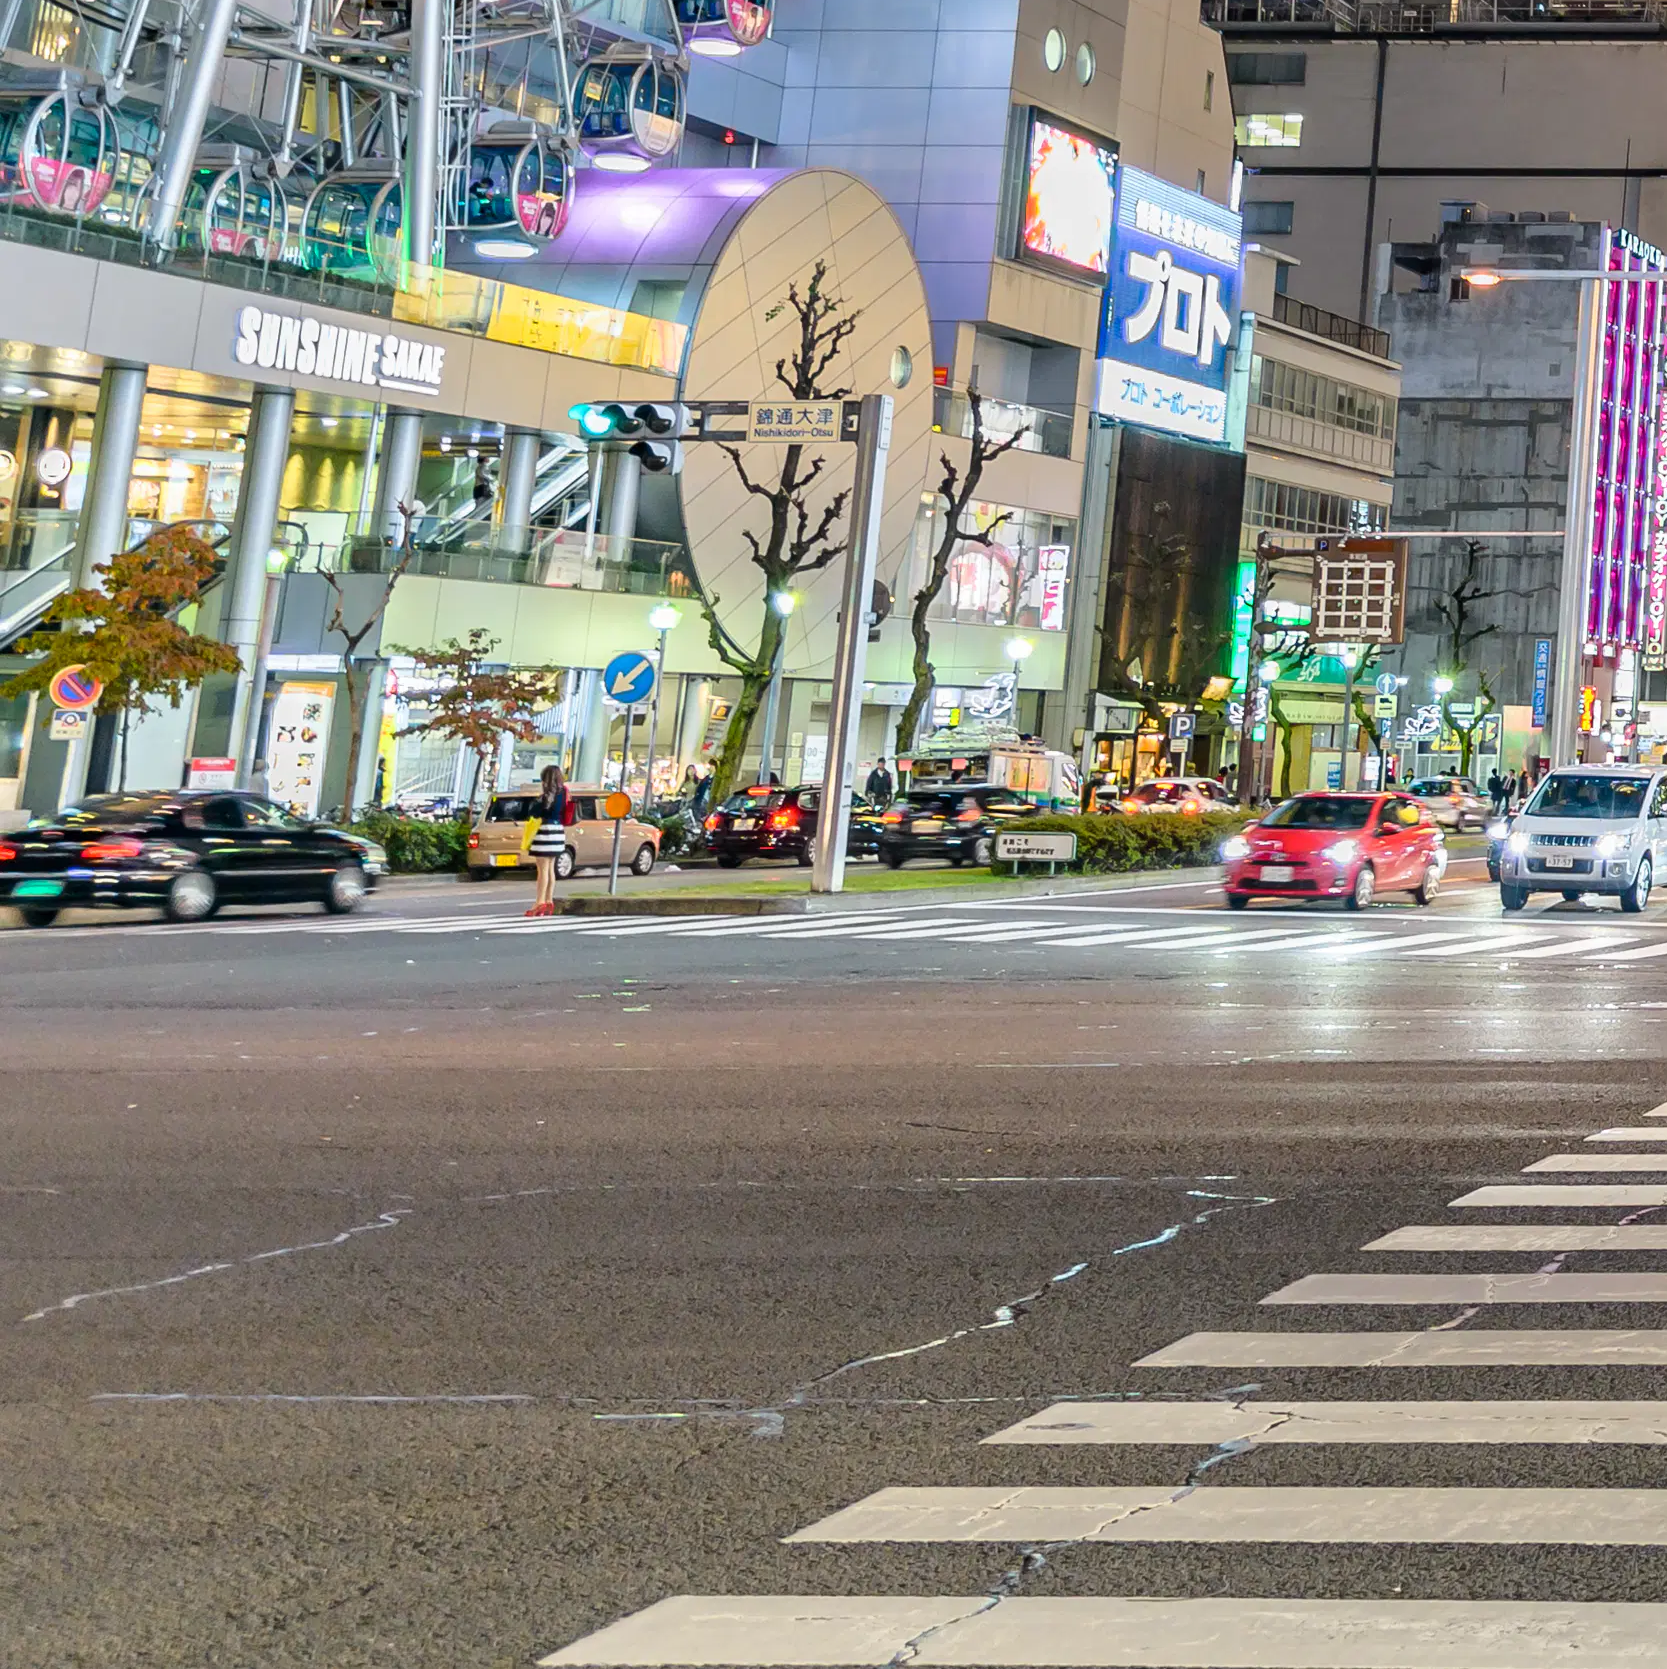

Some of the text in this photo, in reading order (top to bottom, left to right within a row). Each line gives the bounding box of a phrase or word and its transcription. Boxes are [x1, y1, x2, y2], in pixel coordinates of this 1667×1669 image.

[1620, 228, 1663, 267] KARAOKE
[1125, 250, 1231, 365] プロト
[235, 305, 446, 386] SUNSHINE SAKAE
[755, 407, 834, 426] 錦通大津
[1121, 377, 1223, 423] プロト コーポレーション
[753, 427, 834, 437] Nishikidori-Otsu
[1175, 717, 1190, 737] P
